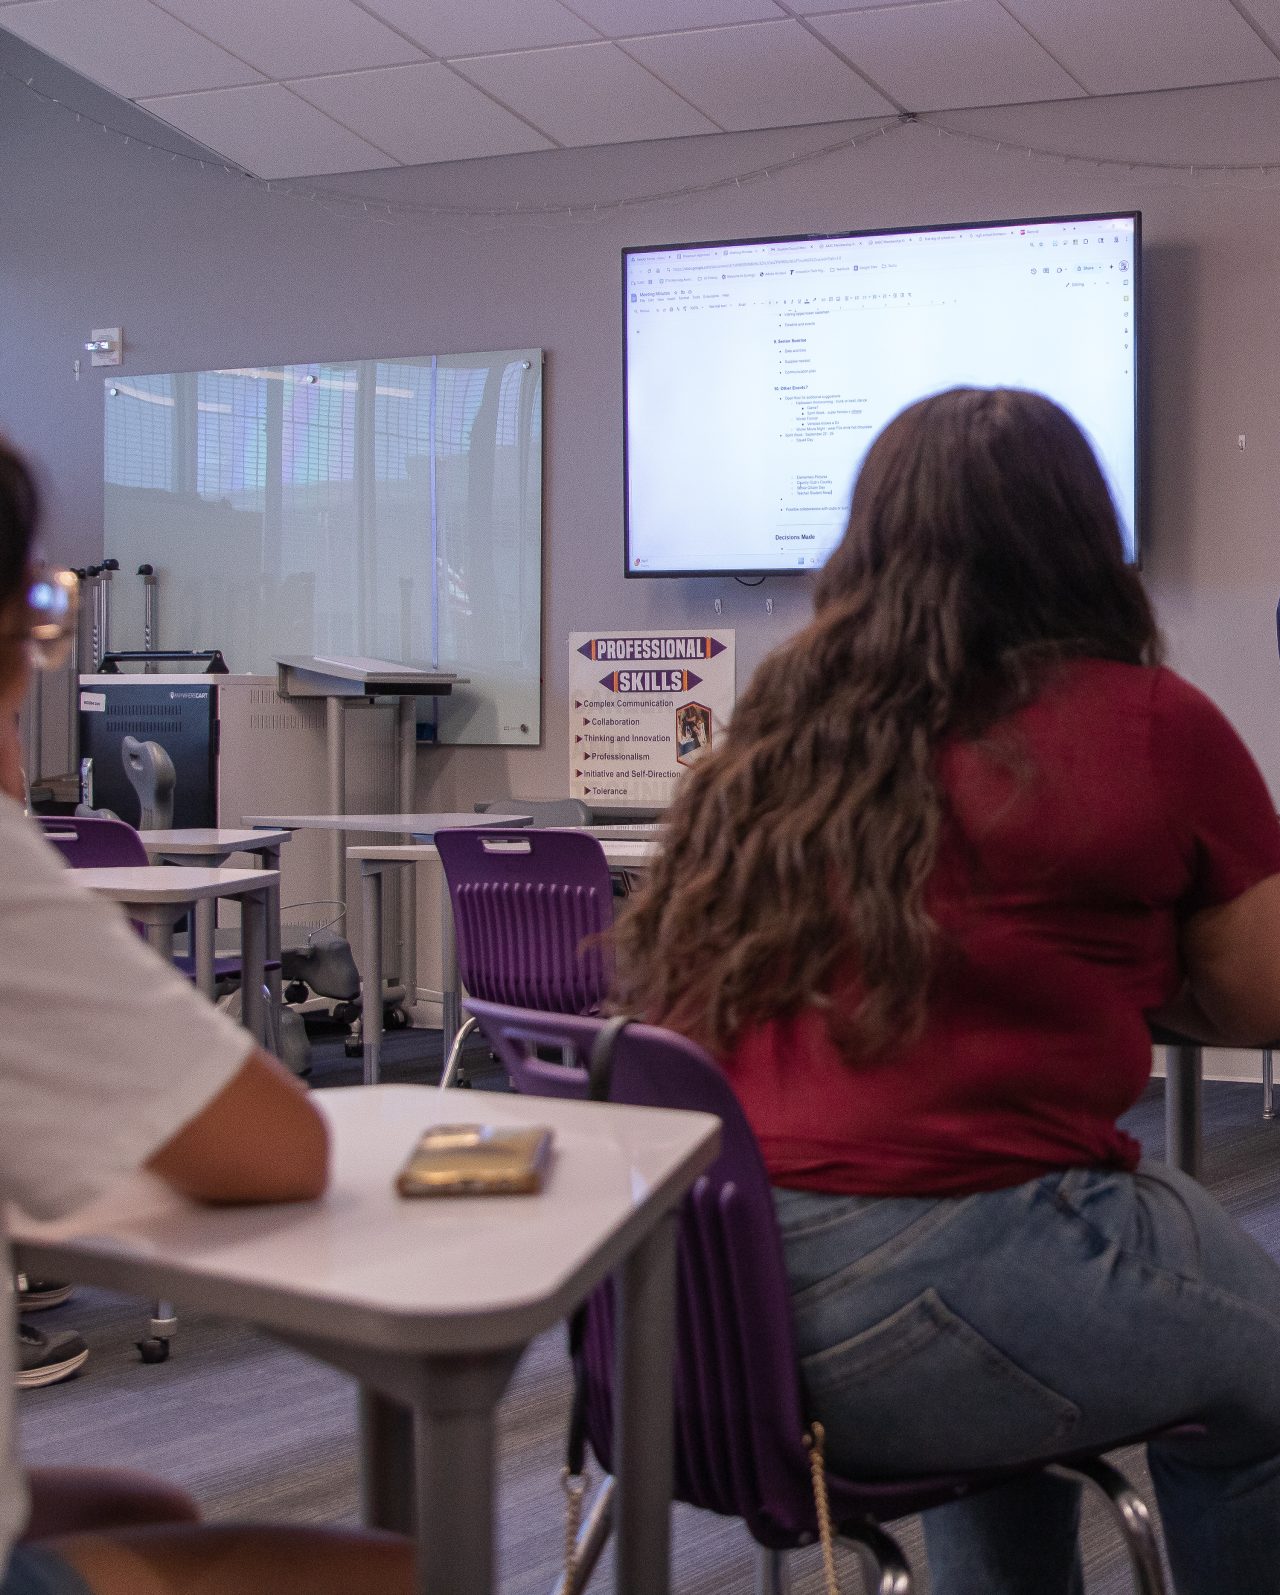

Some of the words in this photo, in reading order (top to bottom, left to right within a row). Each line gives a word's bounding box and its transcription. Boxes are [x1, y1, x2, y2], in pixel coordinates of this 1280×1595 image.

[597, 638, 705, 660] PROFESSIONAL
[619, 671, 683, 691] SKILLS
[583, 700, 615, 709] Complex
[591, 718, 640, 726] Collaboration
[584, 735, 615, 744] Thinking
[591, 752, 650, 761] Professionalism
[583, 770, 614, 778] Initiative
[616, 770, 629, 778] and
[631, 770, 681, 779] Self-Direction
[593, 787, 628, 795] Tolerance
